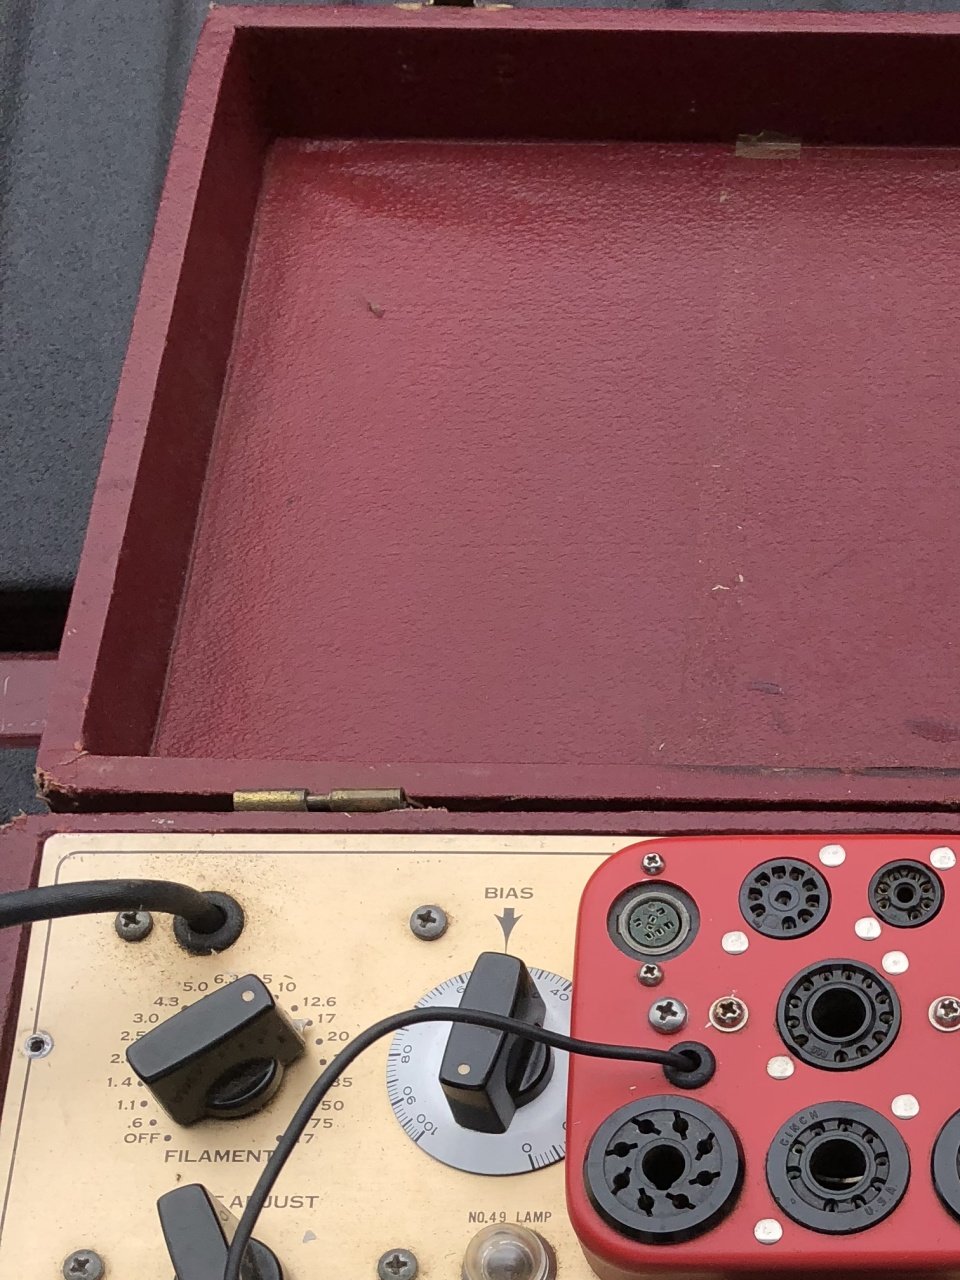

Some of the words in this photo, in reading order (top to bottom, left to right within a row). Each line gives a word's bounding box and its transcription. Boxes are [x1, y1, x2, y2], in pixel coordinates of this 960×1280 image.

[484, 887, 534, 900] BIAS
[183, 982, 208, 992] 5.0
[278, 982, 296, 992] 10
[550, 988, 570, 1002] 40
[154, 997, 179, 1007] 4.3
[303, 997, 337, 1007] 12.6
[132, 1013, 159, 1024] 3.0
[318, 1013, 337, 1024] 17
[328, 1031, 350, 1042] 20
[107, 1078, 132, 1088] 1.4
[400, 1044, 412, 1064] 80
[416, 1113, 438, 1136] 100
[118, 1100, 136, 1110] 1.1
[321, 1101, 344, 1111] 50
[311, 1119, 333, 1129] 75
[124, 1133, 160, 1144] OFF
[165, 1150, 277, 1163] FILAMENT
[230, 1196, 320, 1208] AJUST
[468, 1211, 508, 1224] NO.49
[516, 1211, 552, 1224] LAMP
